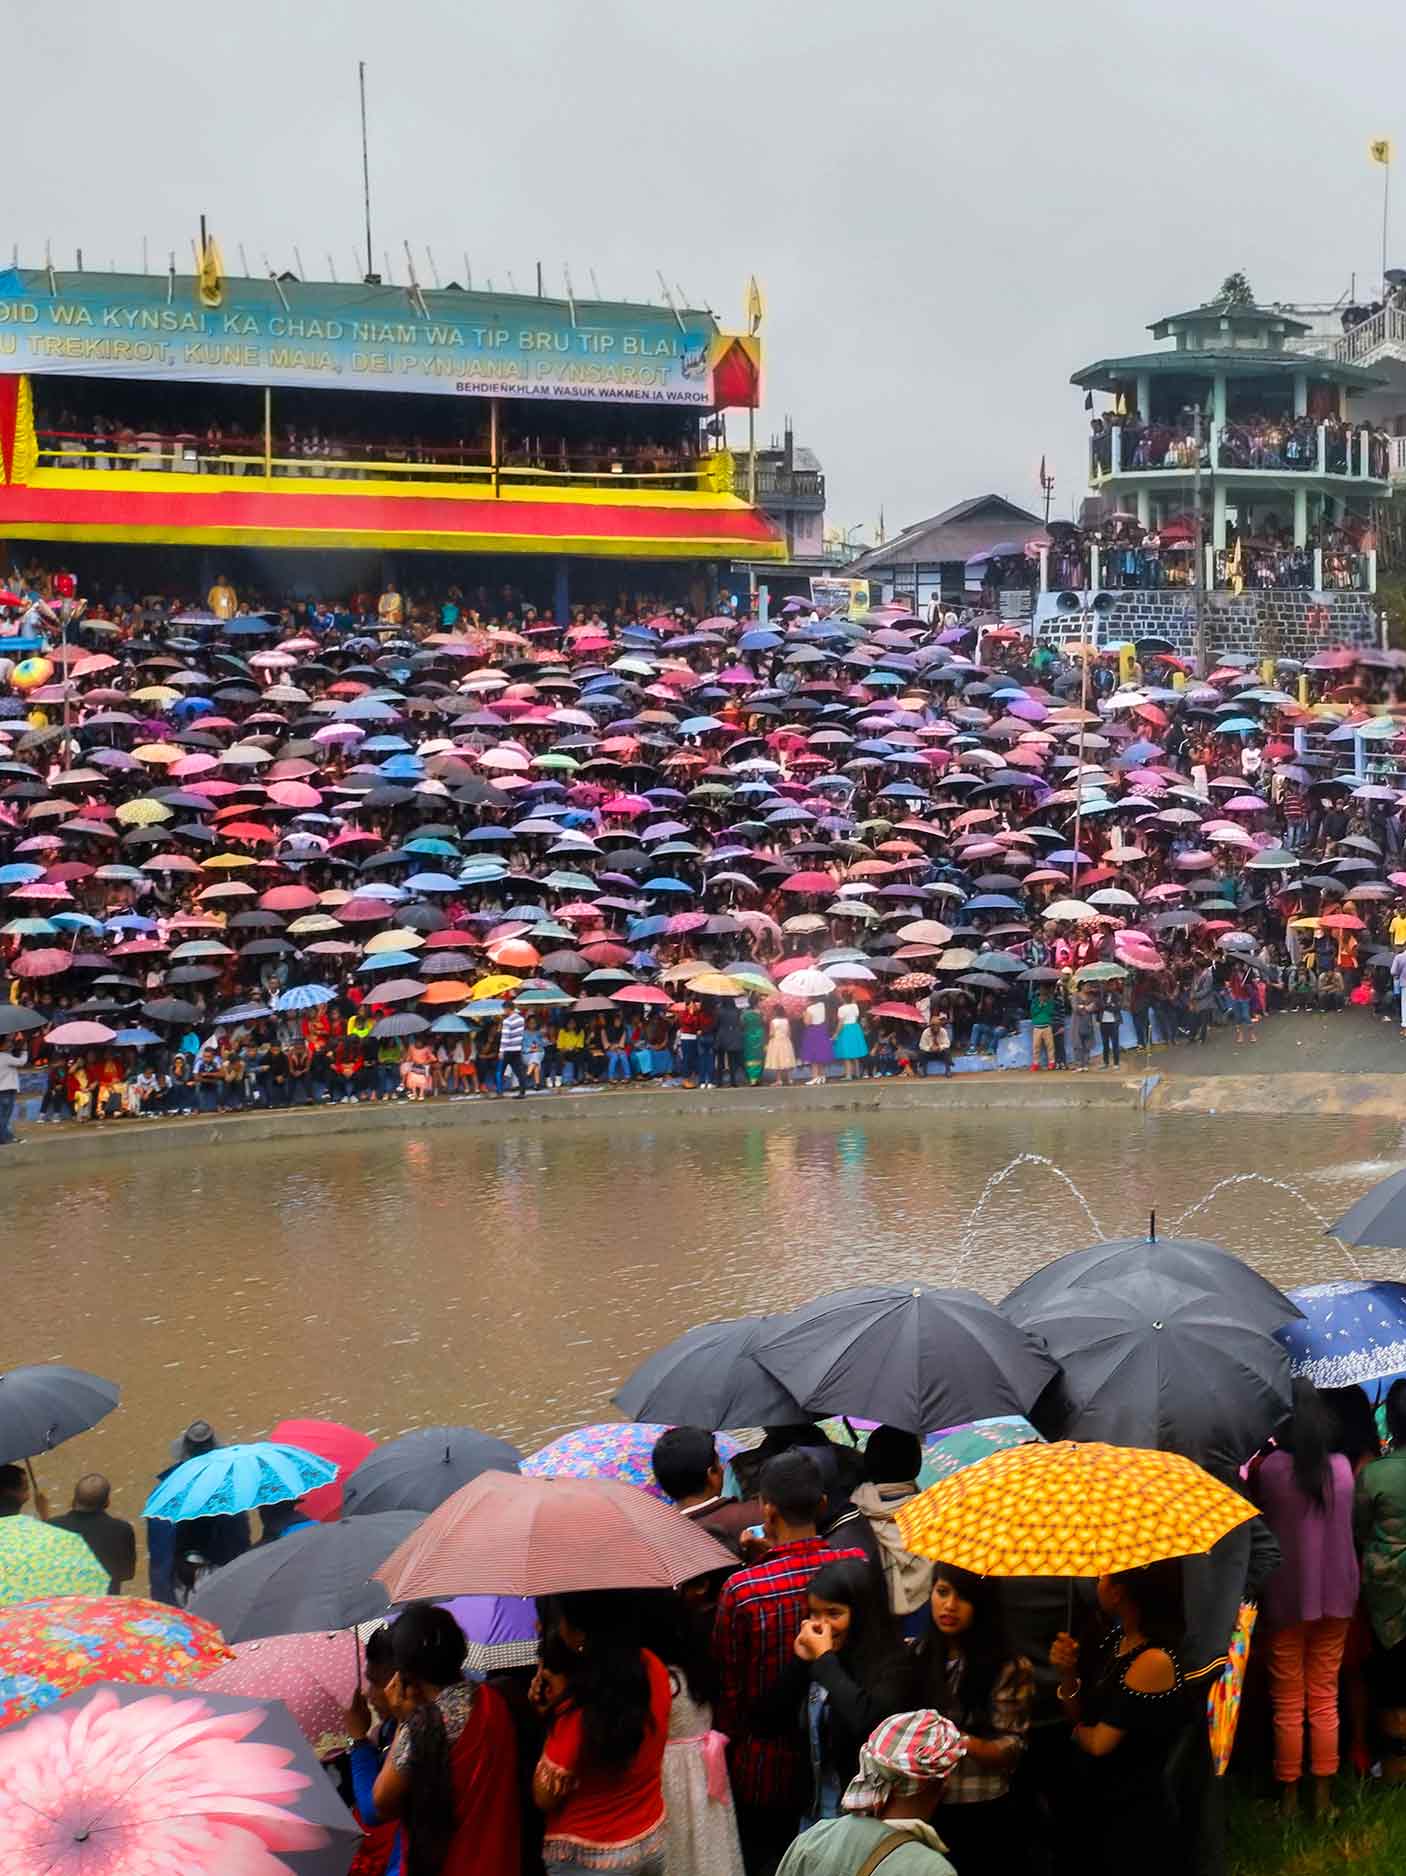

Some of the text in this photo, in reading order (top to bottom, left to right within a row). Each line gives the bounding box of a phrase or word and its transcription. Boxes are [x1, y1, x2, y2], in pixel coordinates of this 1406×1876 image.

[49, 304, 95, 327] WA
[103, 307, 213, 336] KYNSAI,
[224, 313, 262, 336] KA
[269, 317, 343, 340] CHAD
[352, 321, 417, 344] NIAM
[424, 326, 465, 347] WA
[472, 329, 510, 351] TIP
[520, 331, 569, 352] BRU
[577, 334, 615, 354] TIP
[623, 336, 678, 357] BLAI
[184, 343, 258, 367] KUNE
[552, 386, 595, 397] WASUK
